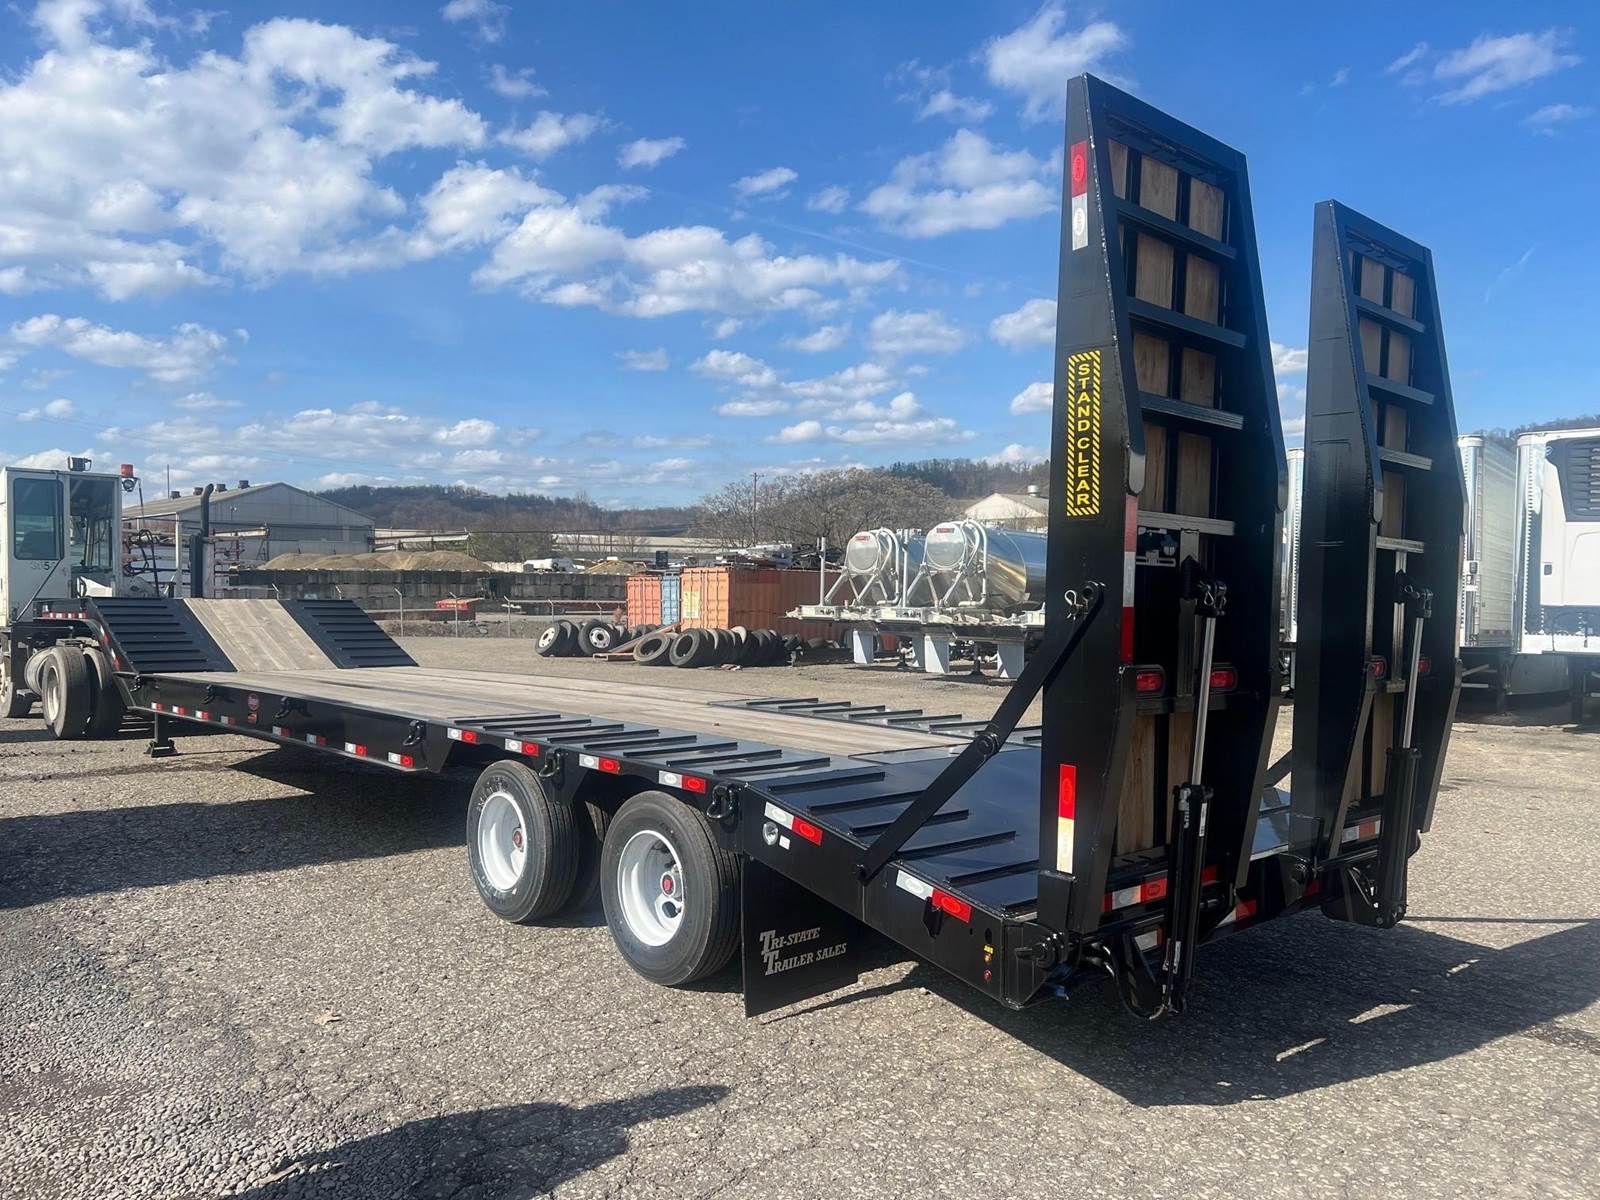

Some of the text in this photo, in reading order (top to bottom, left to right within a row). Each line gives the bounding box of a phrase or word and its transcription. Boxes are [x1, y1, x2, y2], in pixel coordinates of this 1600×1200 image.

[1076, 363, 1091, 506] STAND CLEAR
[759, 927, 821, 956] TRI-STATE
[763, 942, 847, 976] TRAILER SALES
